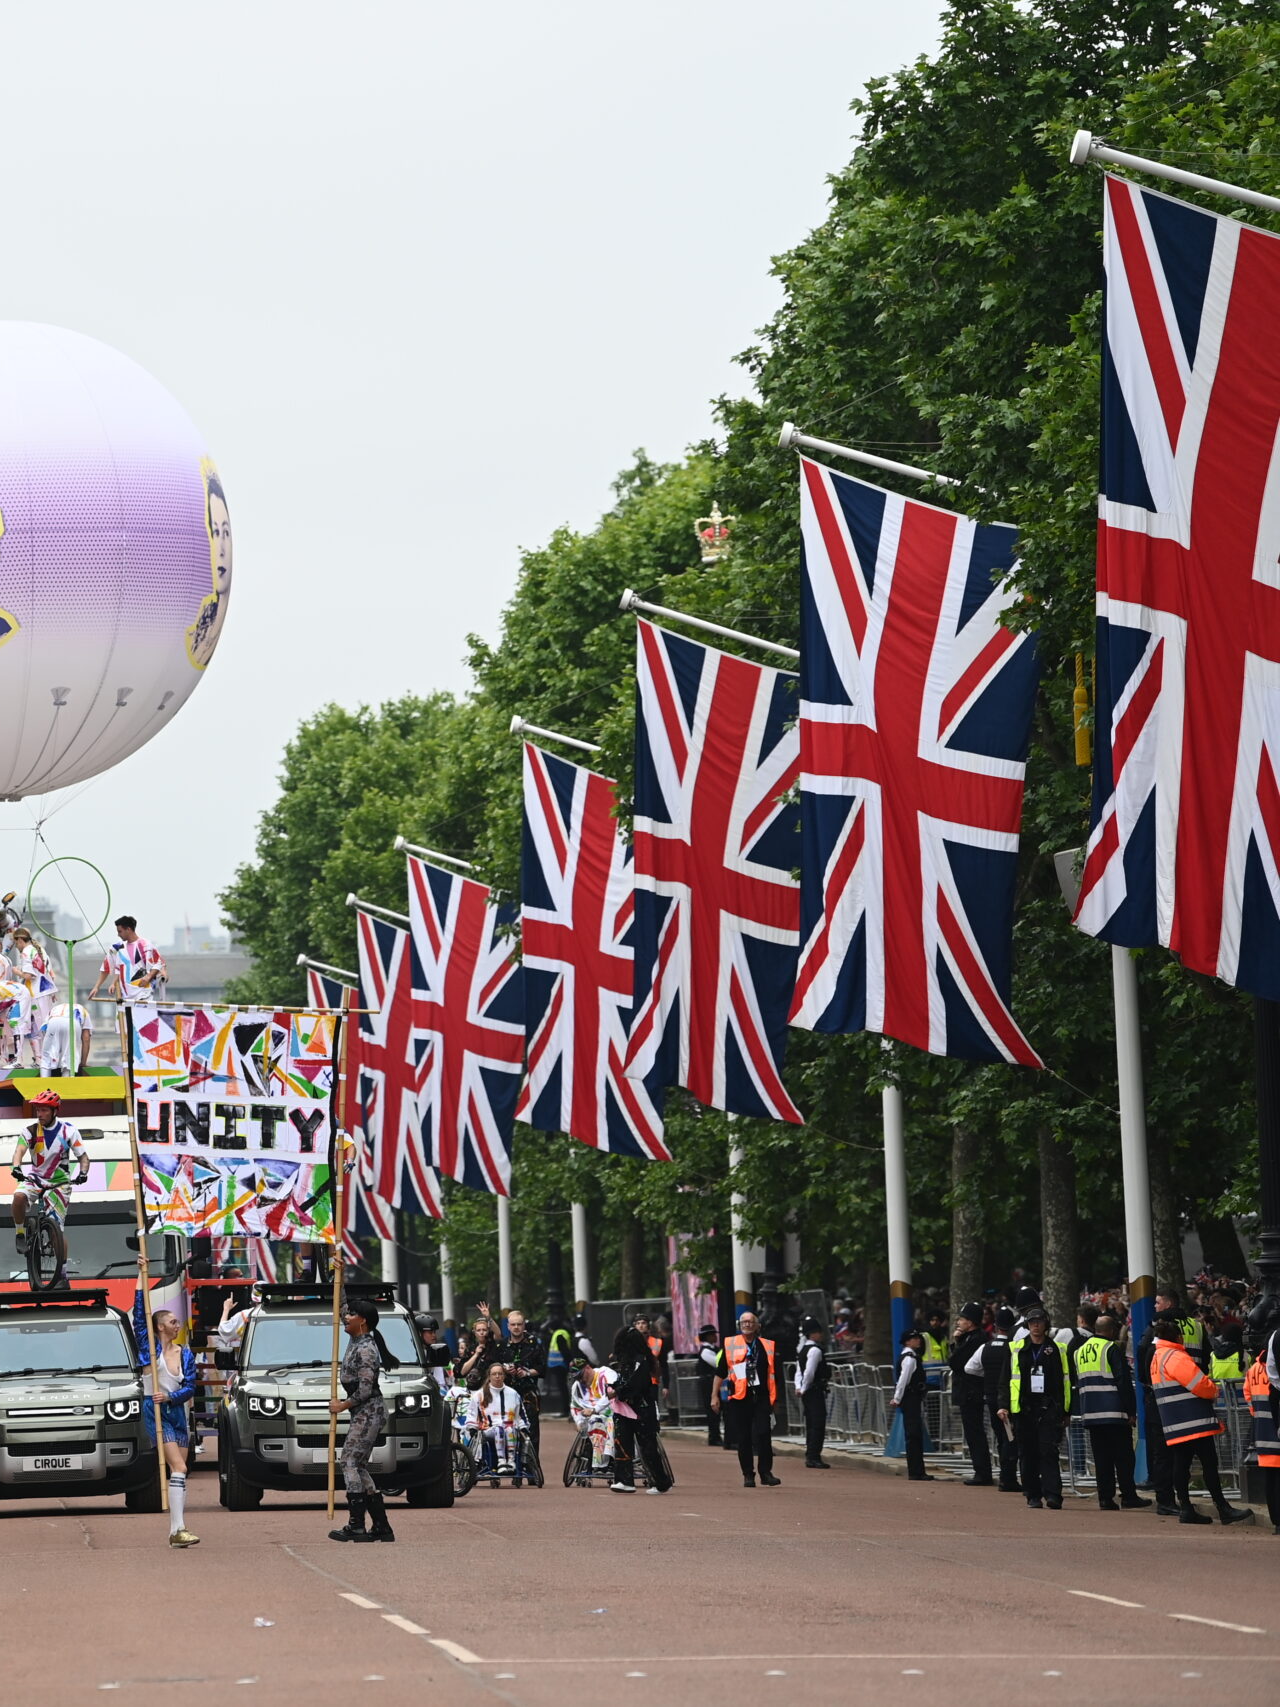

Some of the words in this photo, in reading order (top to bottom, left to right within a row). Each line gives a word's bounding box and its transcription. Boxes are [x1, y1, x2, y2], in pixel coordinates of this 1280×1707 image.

[136, 1098, 326, 1153] UNITY
[1179, 1318, 1195, 1336] PS
[1079, 1342, 1100, 1365] APS
[7, 1393, 91, 1402] DEFENDER
[34, 1457, 71, 1469] CIRQUE
